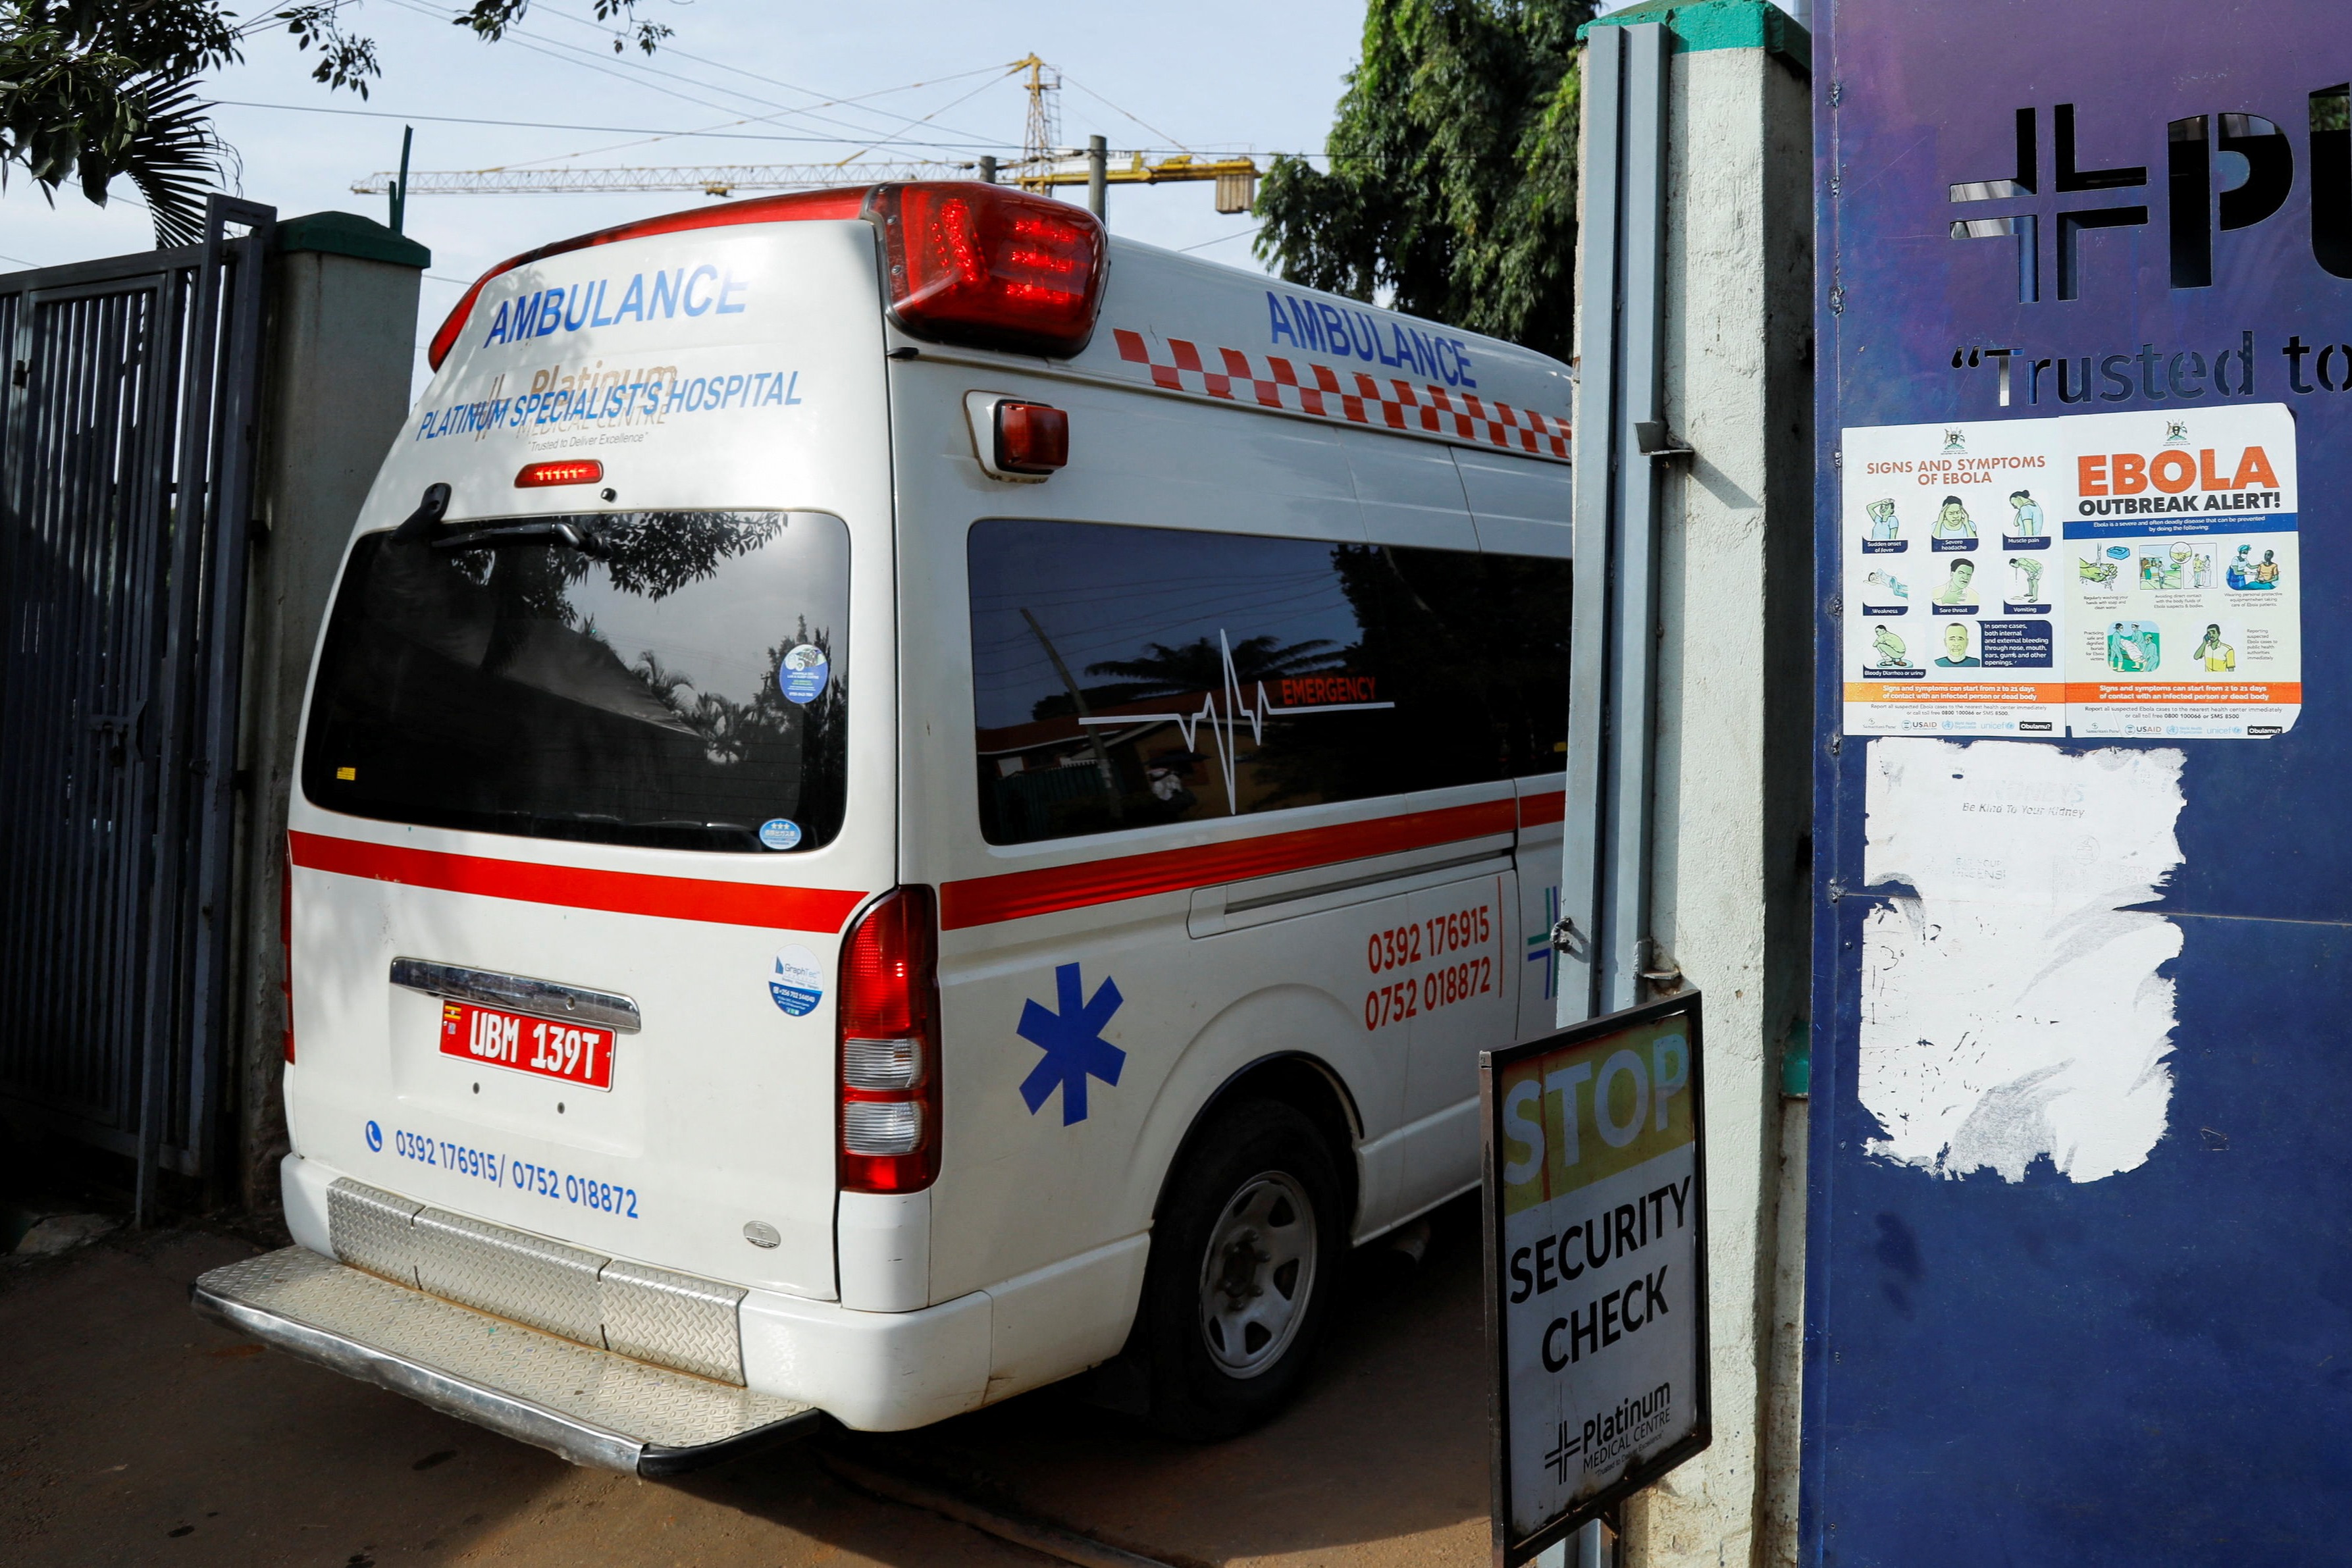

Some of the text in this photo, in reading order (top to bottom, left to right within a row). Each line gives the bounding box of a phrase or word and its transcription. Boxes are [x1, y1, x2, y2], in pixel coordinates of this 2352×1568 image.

[484, 265, 749, 349] AMBULANCE
[1266, 290, 1477, 388] AMBULANCE
[531, 361, 677, 408] Platinum
[2282, 336, 2352, 394] to
[416, 371, 802, 442] PLATINUM SPECIALIST'S HOSPITAL
[560, 437, 568, 448] to
[569, 434, 600, 447] Deliver
[1867, 456, 2046, 475] SIGNS AND SYMPTOMS
[1918, 471, 1992, 486] OF EBOLA
[2078, 446, 2280, 497] EBOLA
[2078, 492, 2281, 516] OUTBREAK ALERT!
[1281, 677, 1376, 704] EMERGENCY
[1962, 803, 1975, 812] Be
[2007, 805, 2018, 814] To
[1368, 905, 1489, 974] 0392 176915
[1365, 956, 1490, 1031] 0752 018872
[469, 1010, 600, 1079] UBM 139T
[1503, 1033, 1690, 1185] STOP
[396, 1130, 436, 1165] 0392
[512, 1161, 560, 1199] 0752
[565, 1175, 639, 1219] 018872
[1510, 1175, 1691, 1304] SECURITY
[1542, 1265, 1669, 1373] CHECK
[1583, 1407, 1671, 1475] MEDICAL CENTRE
[1584, 1382, 1671, 1455] Platinum
